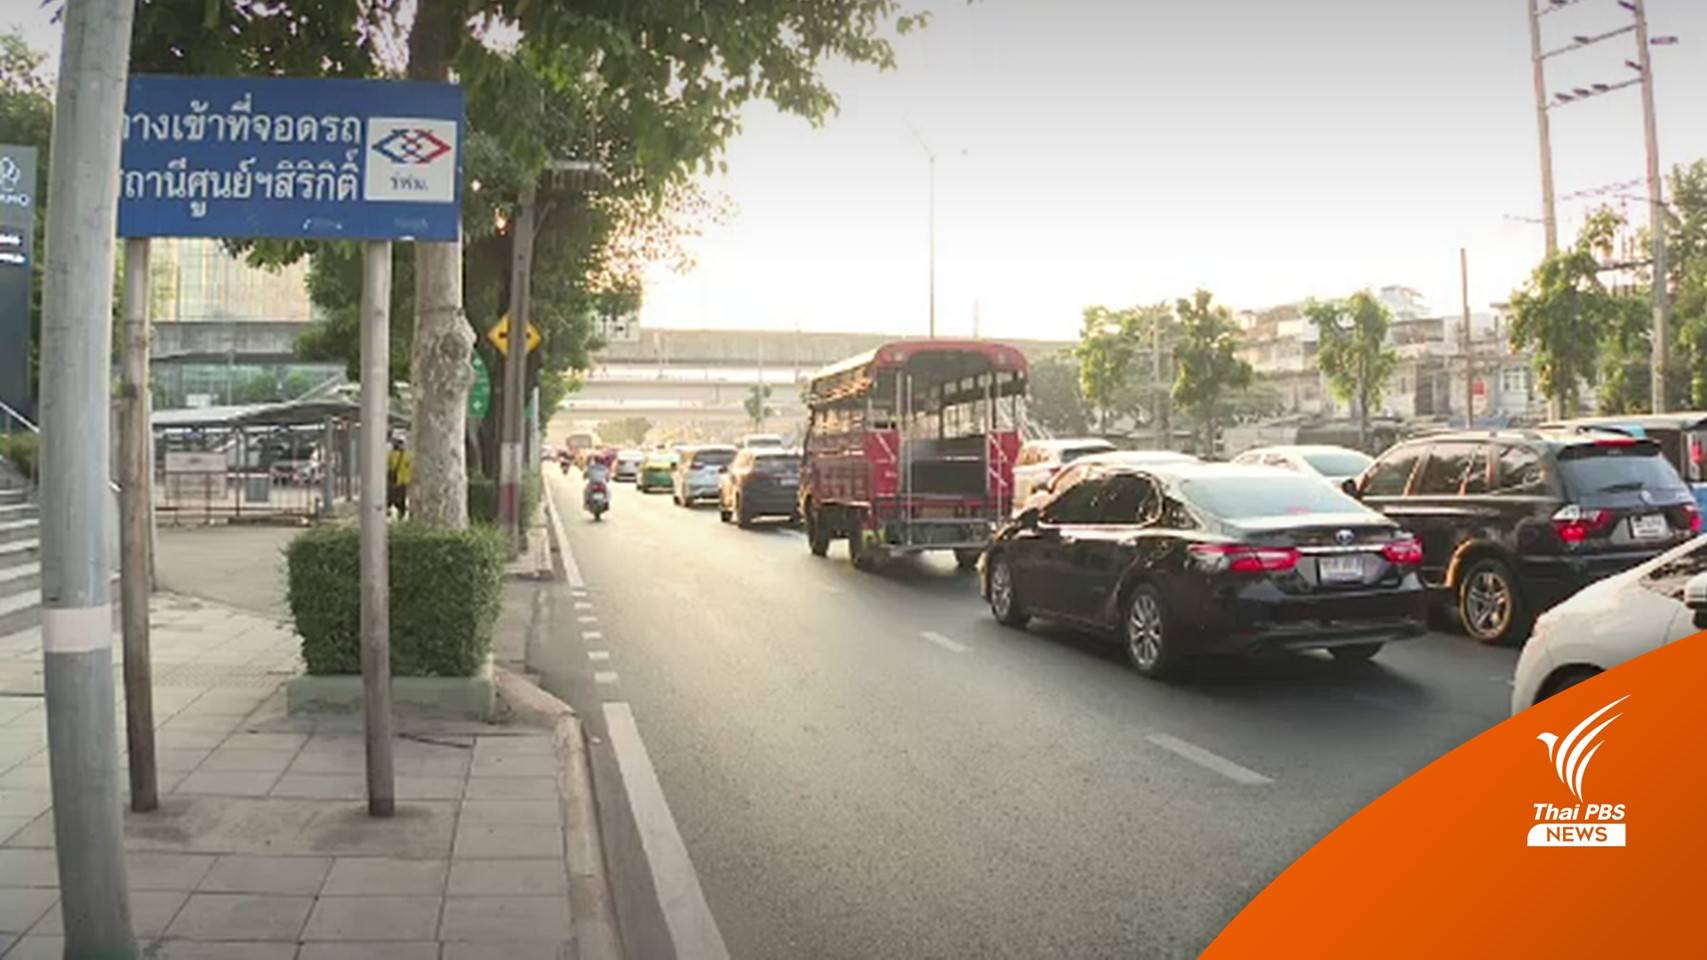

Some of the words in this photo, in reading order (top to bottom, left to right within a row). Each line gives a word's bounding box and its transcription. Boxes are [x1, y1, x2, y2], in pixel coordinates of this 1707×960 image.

[119, 148, 360, 218] ถานีศูนย์ฯสิริกิติ์
